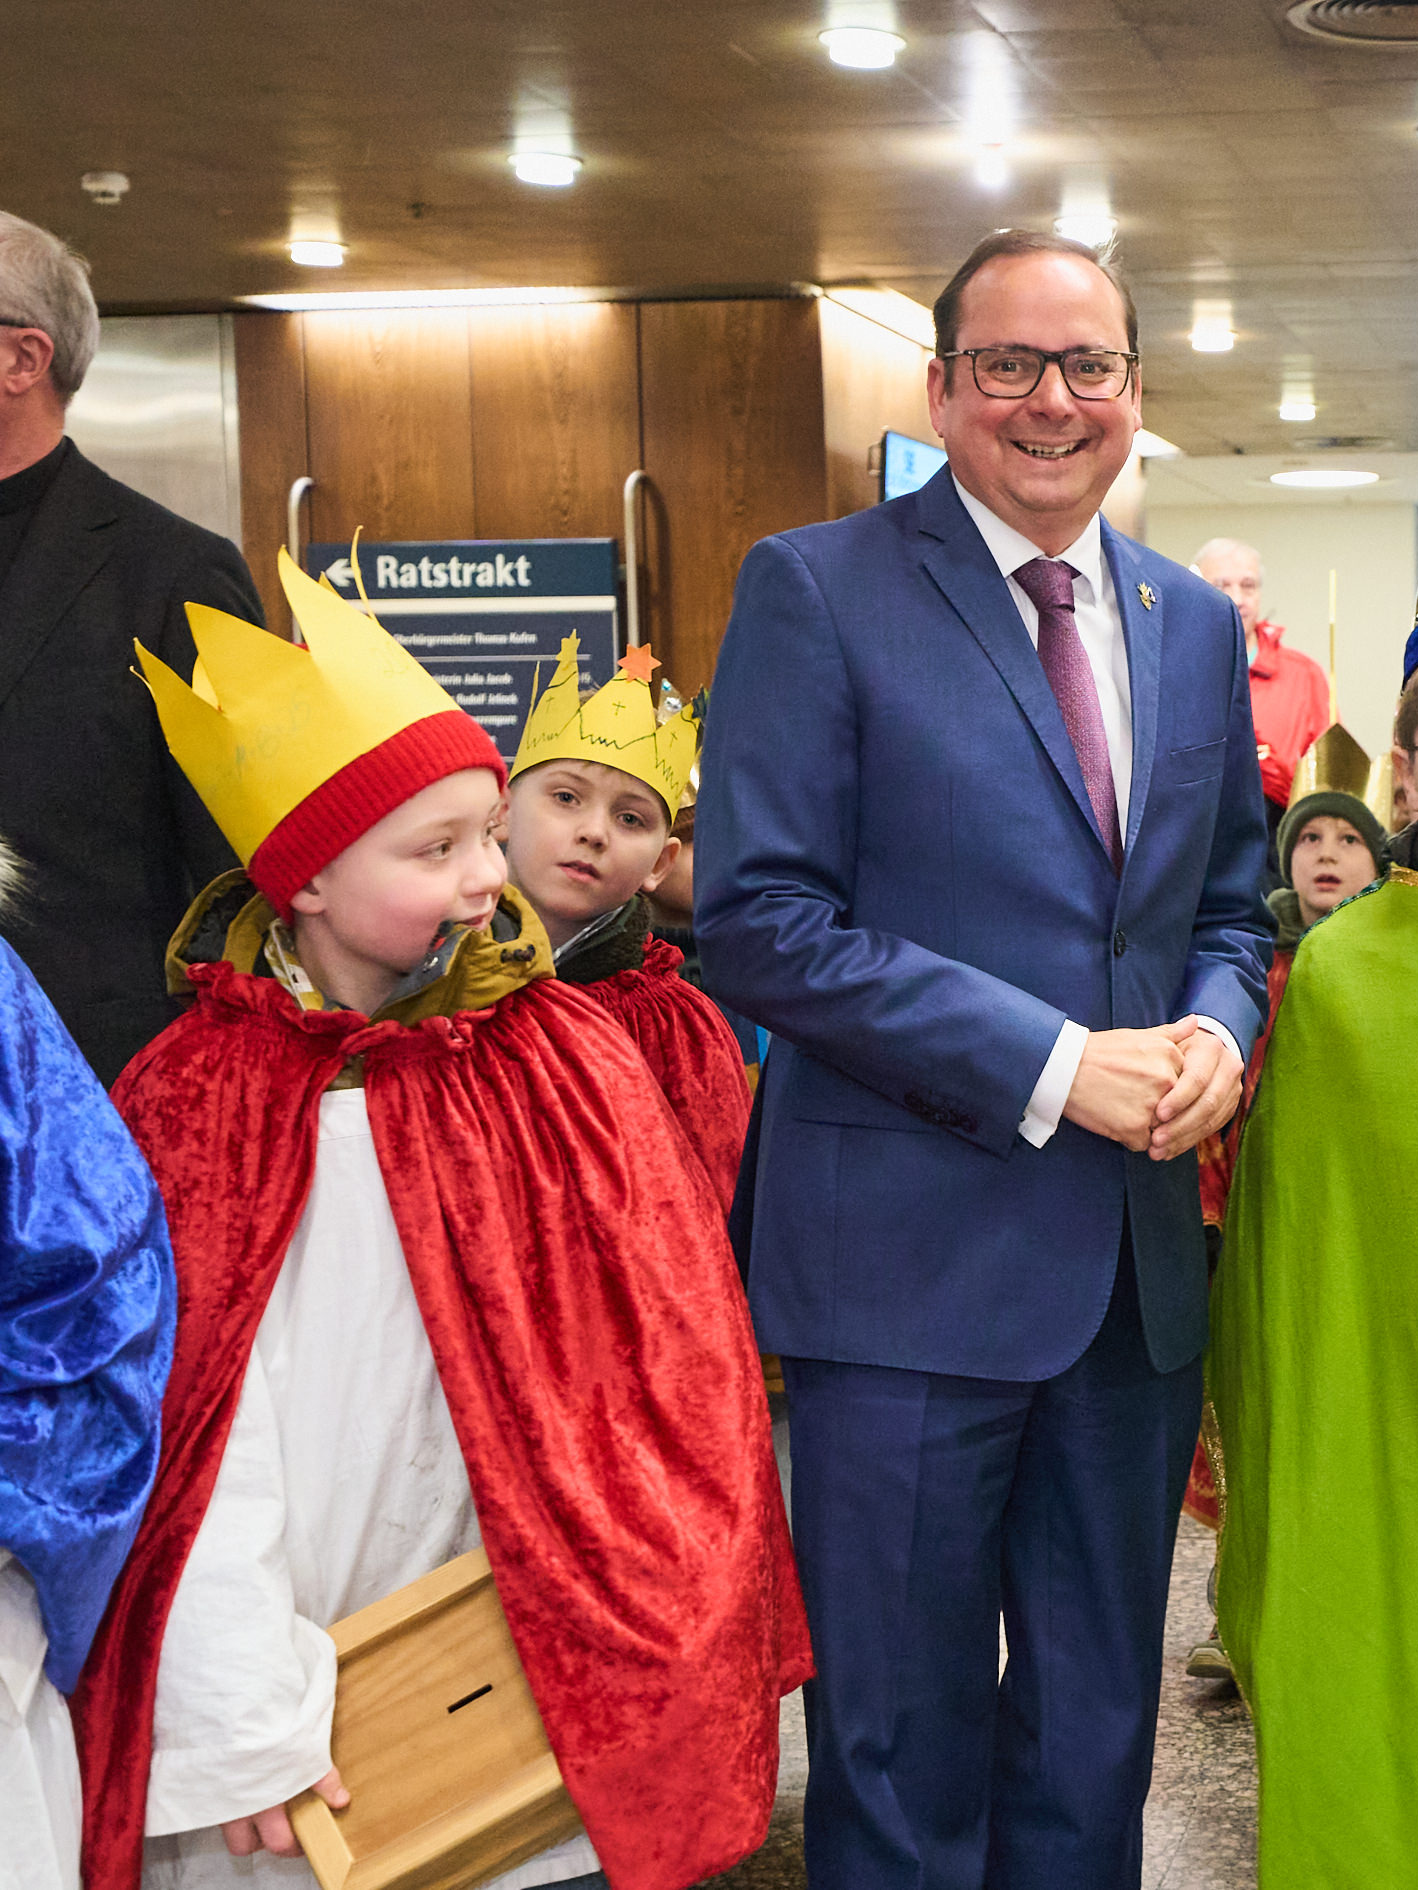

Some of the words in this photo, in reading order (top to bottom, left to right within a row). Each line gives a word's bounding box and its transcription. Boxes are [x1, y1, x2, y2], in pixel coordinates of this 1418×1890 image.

[376, 554, 531, 588] Ratstrakt
[474, 631, 507, 645] Thomas
[509, 631, 538, 645] Kufen
